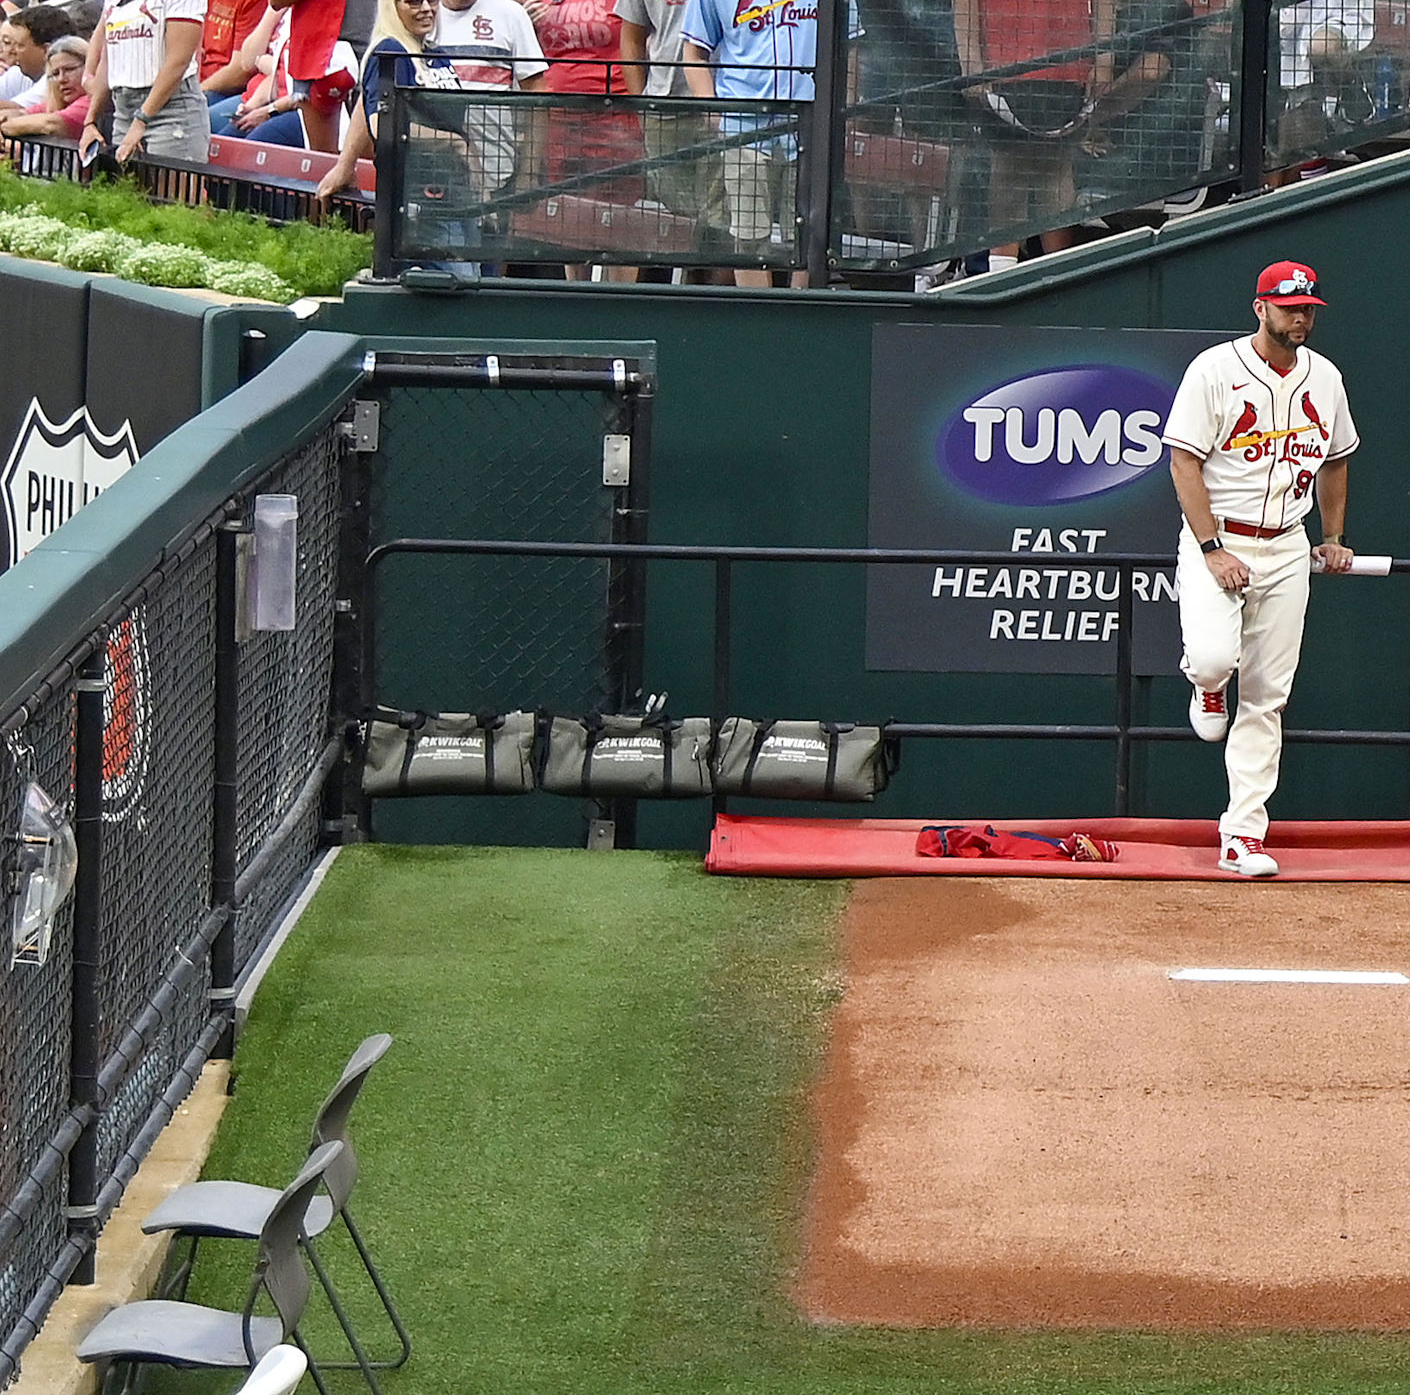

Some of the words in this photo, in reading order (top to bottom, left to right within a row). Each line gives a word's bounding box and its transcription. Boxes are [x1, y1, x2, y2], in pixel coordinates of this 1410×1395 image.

[962, 406, 1164, 468] TUMS
[1278, 431, 1324, 466] Louis
[1010, 527, 1108, 554] FAST
